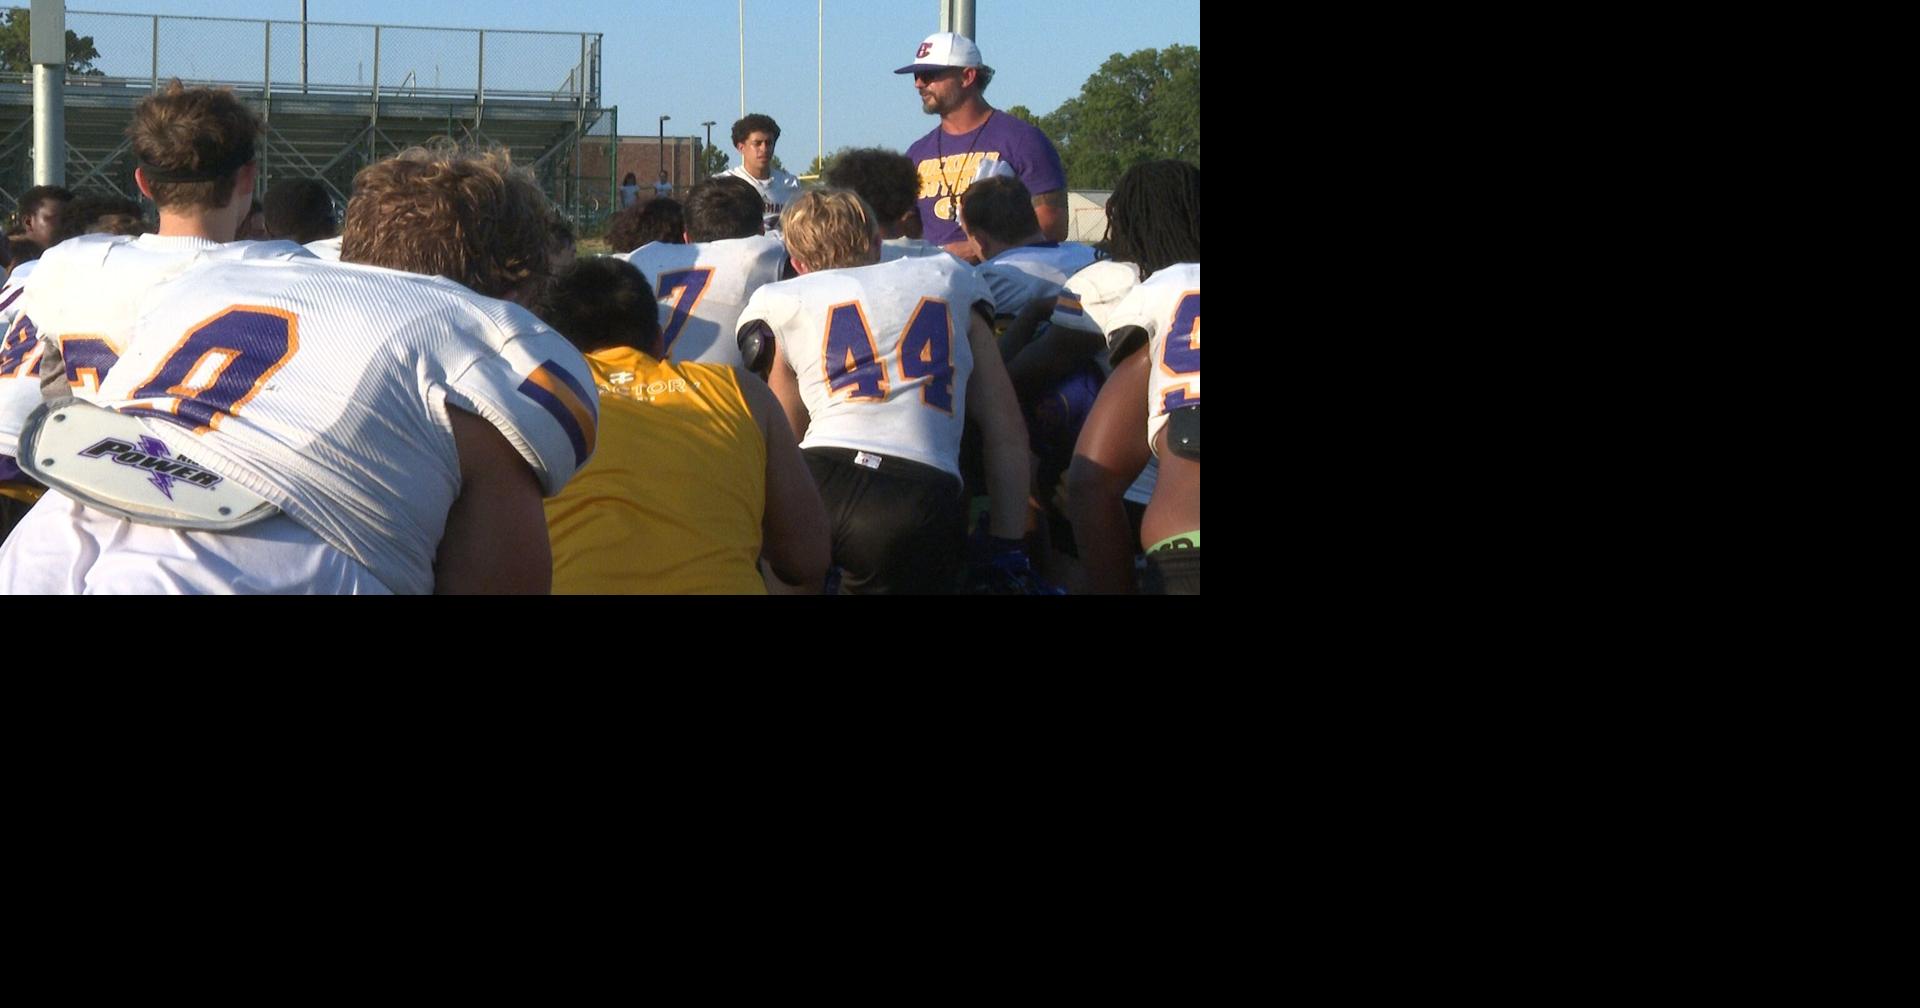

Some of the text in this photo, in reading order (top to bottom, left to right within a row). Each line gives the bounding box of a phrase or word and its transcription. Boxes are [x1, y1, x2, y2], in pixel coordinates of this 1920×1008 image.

[656, 267, 715, 357] 7
[822, 297, 954, 417] 44
[79, 436, 222, 487] POWER
